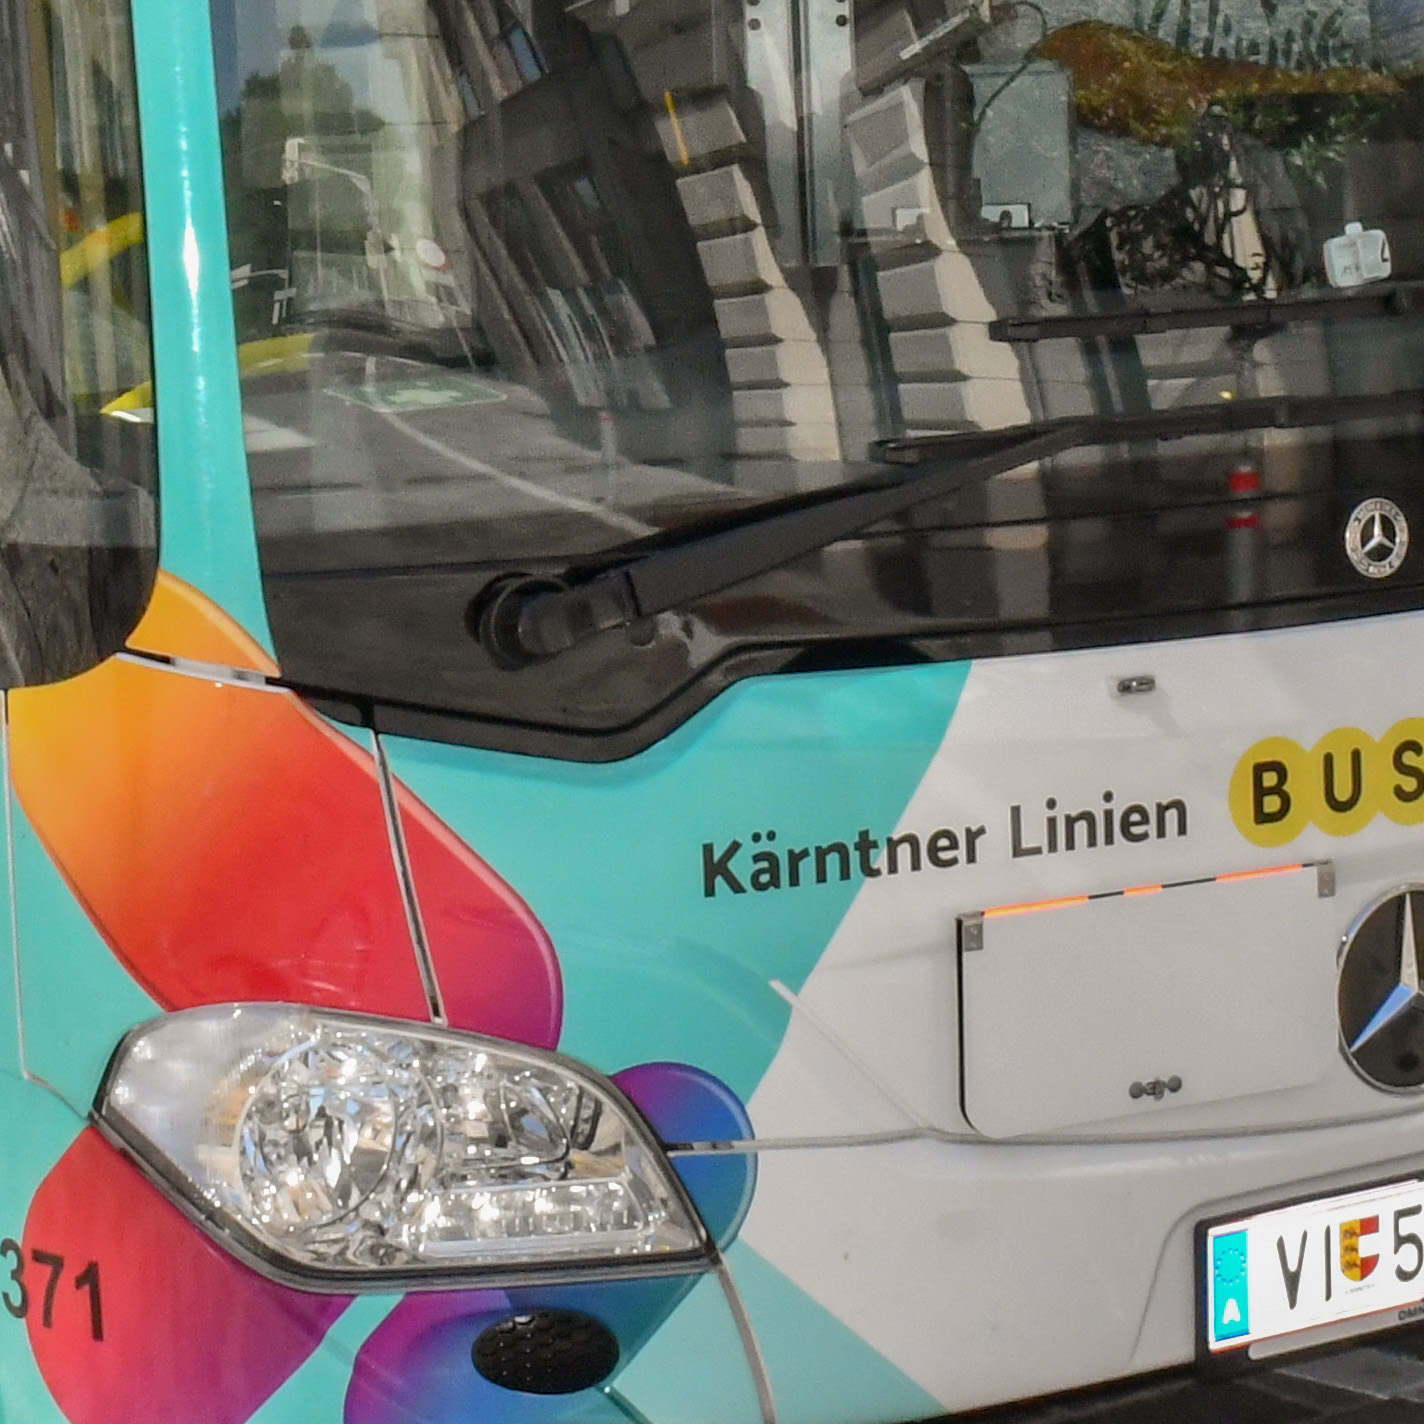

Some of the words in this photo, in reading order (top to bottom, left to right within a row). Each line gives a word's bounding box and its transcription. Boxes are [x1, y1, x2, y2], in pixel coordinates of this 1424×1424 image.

[702, 823, 987, 898] Kärntner
[1009, 789, 1188, 859] Linien
[1221, 1297, 1242, 1326] A
[1275, 1223, 1332, 1311] VI
